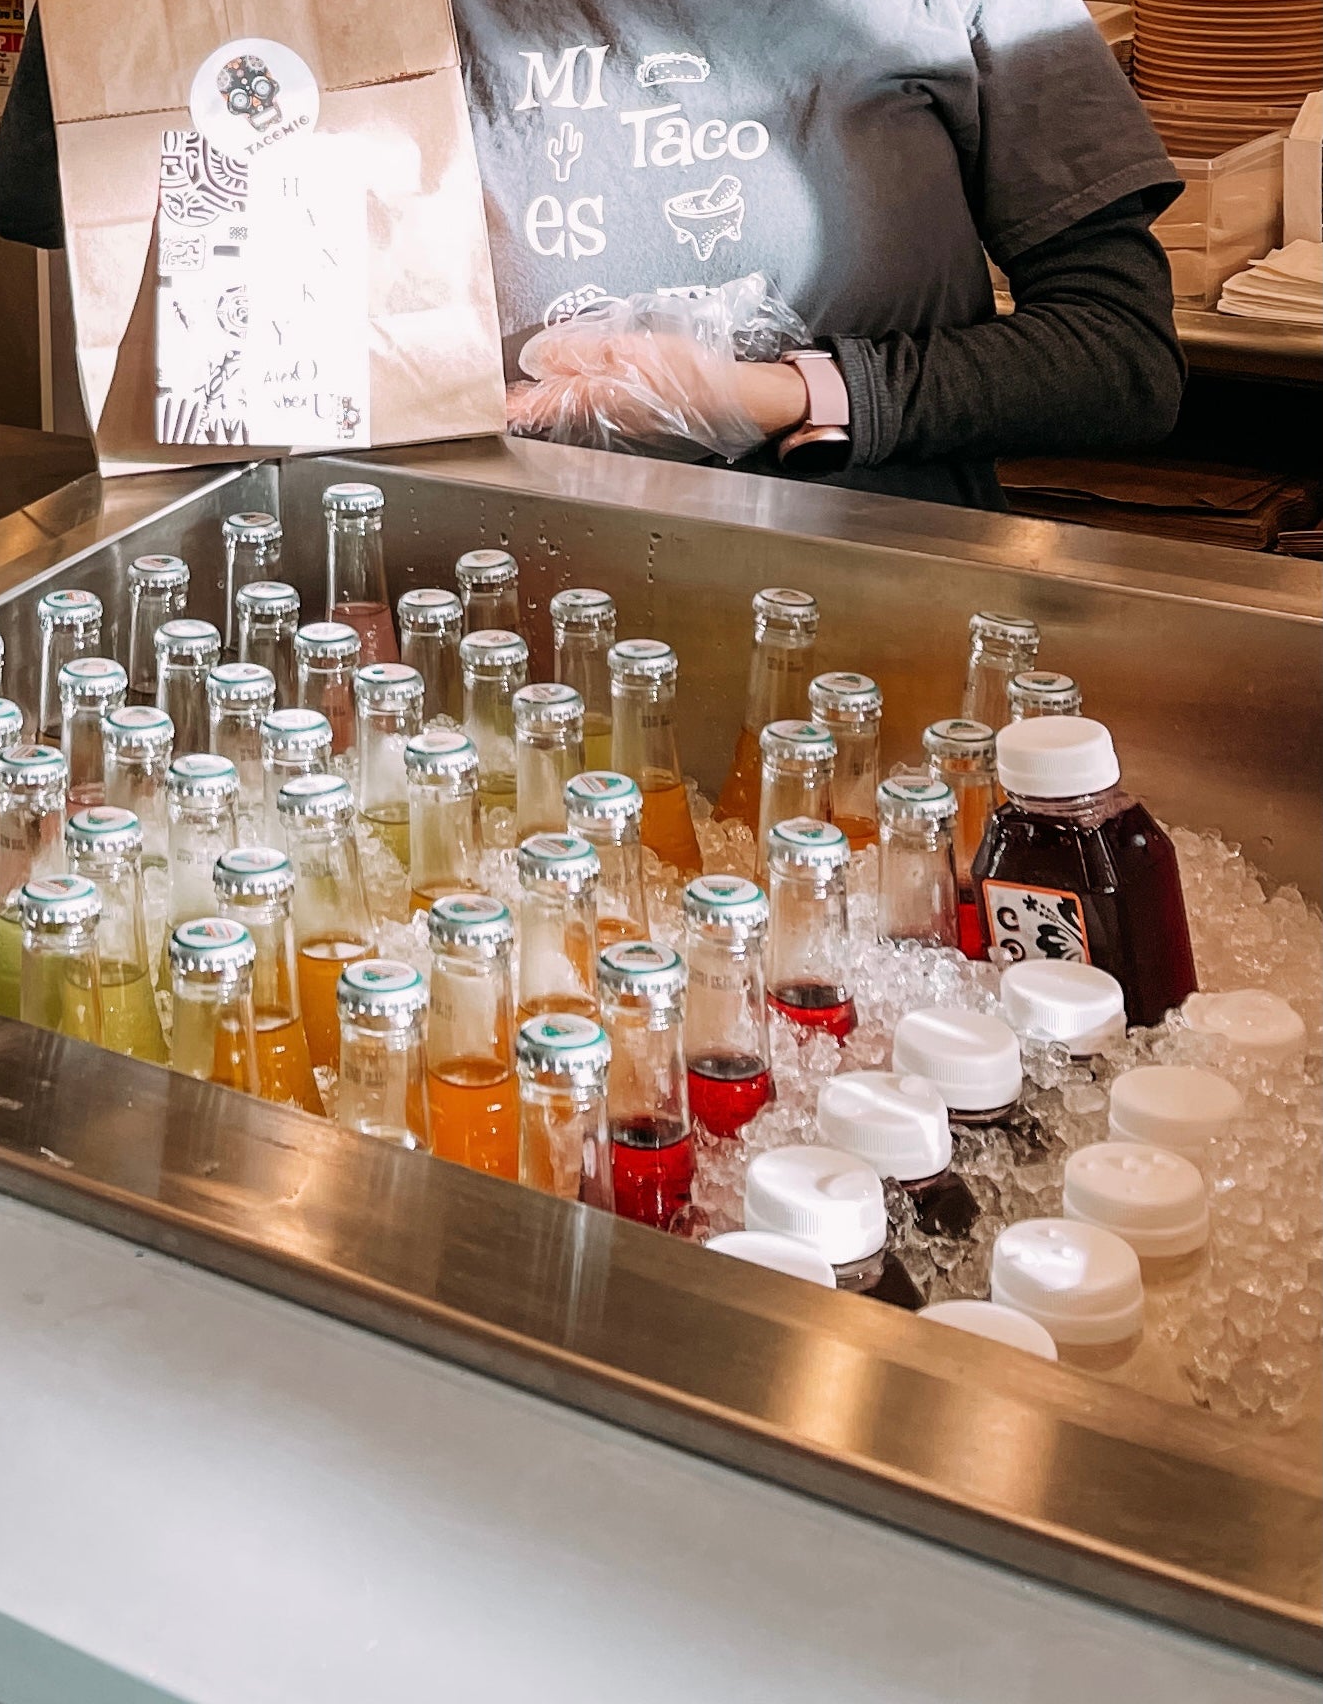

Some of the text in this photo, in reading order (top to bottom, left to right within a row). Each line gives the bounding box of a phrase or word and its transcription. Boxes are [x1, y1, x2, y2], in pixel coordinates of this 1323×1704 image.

[243, 114, 310, 156] TACOMIO
[619, 102, 771, 169] Taco
[524, 193, 607, 261] es
